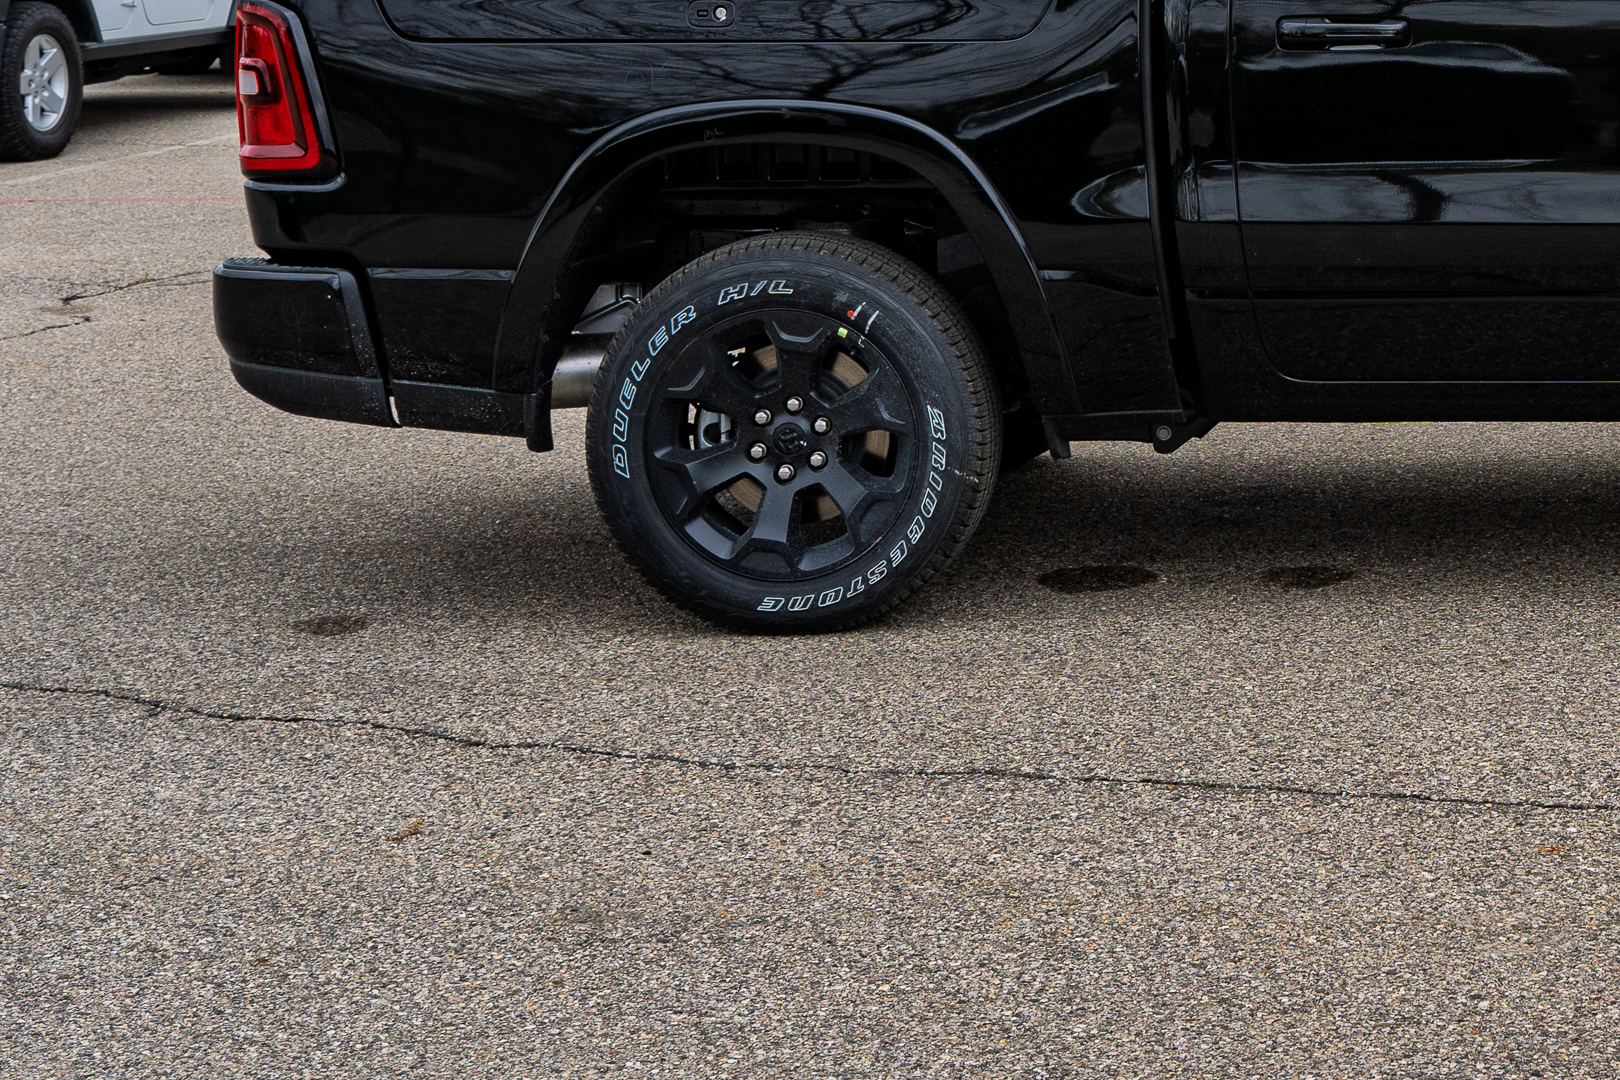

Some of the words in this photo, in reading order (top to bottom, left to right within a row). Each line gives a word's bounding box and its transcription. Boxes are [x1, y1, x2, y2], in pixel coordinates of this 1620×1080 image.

[612, 305, 697, 479] DUELER
[717, 279, 794, 306] H/L
[757, 404, 947, 612] BRIDGESTONE
